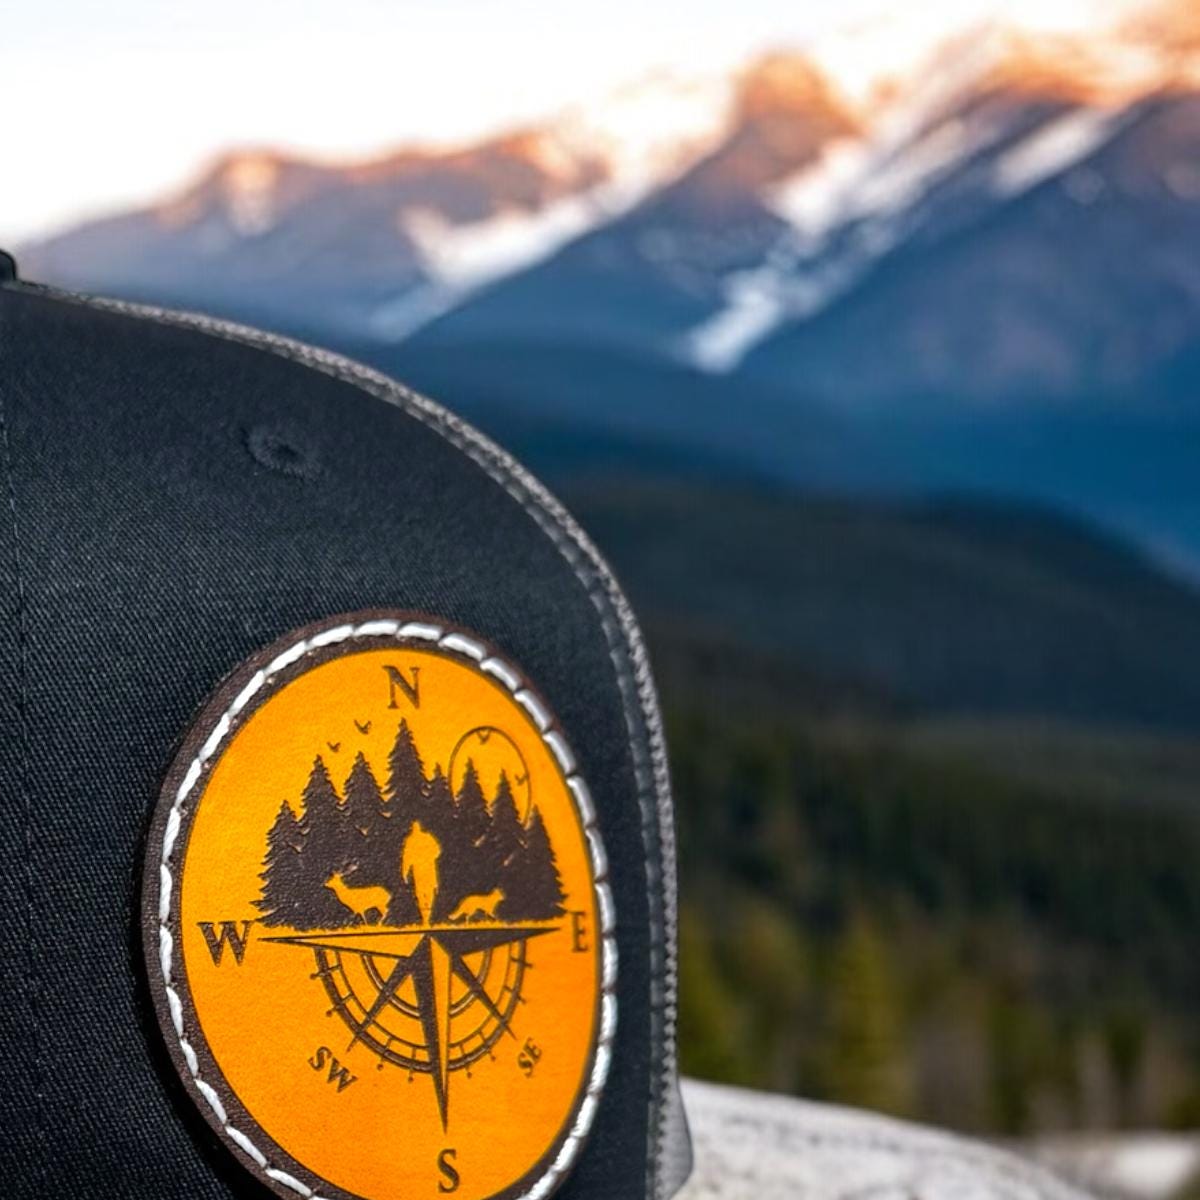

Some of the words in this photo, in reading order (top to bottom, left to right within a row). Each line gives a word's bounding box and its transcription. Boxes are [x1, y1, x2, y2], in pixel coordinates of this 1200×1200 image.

[382, 665, 421, 710] N
[198, 920, 256, 966] W
[569, 911, 589, 953] E
[307, 1046, 359, 1093] SW
[437, 1149, 461, 1194] S
